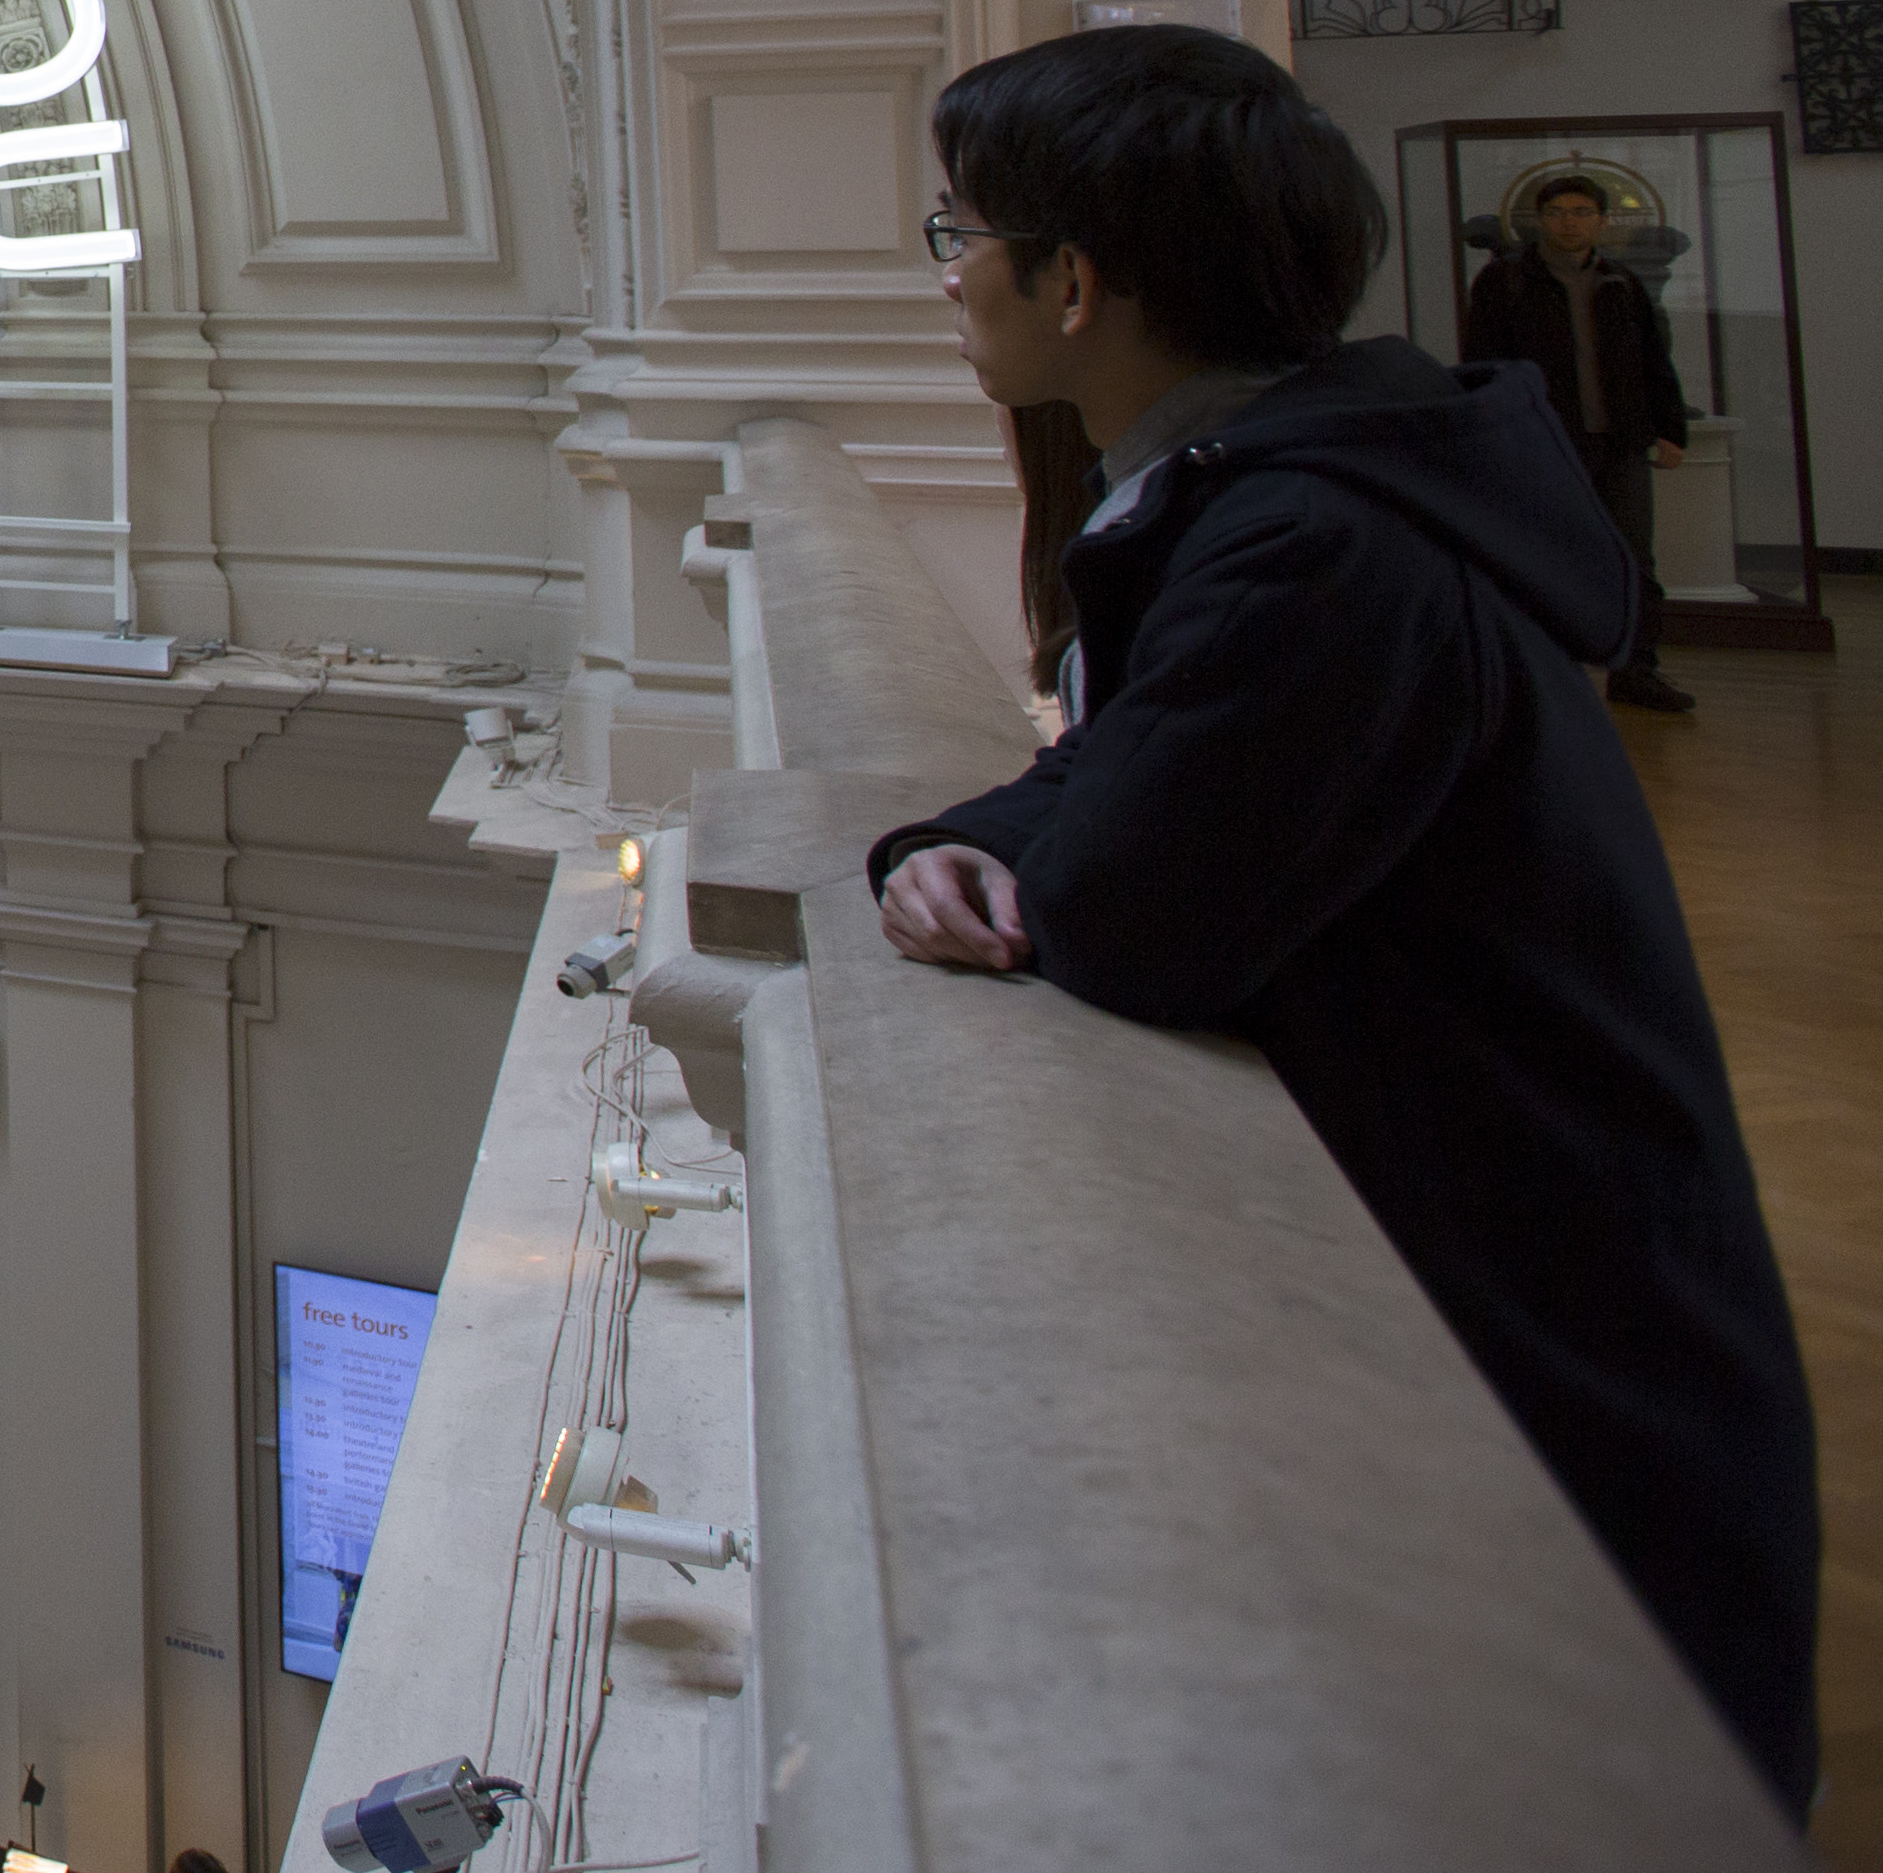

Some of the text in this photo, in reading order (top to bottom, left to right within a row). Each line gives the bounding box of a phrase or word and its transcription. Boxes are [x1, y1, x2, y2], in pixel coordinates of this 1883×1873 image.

[303, 1302, 409, 1340] free tours
[342, 1347, 397, 1366] introductory
[343, 1449, 394, 1465] performan
[344, 1493, 382, 1507] introduc
[165, 1635, 226, 1660] SAMSUNG
